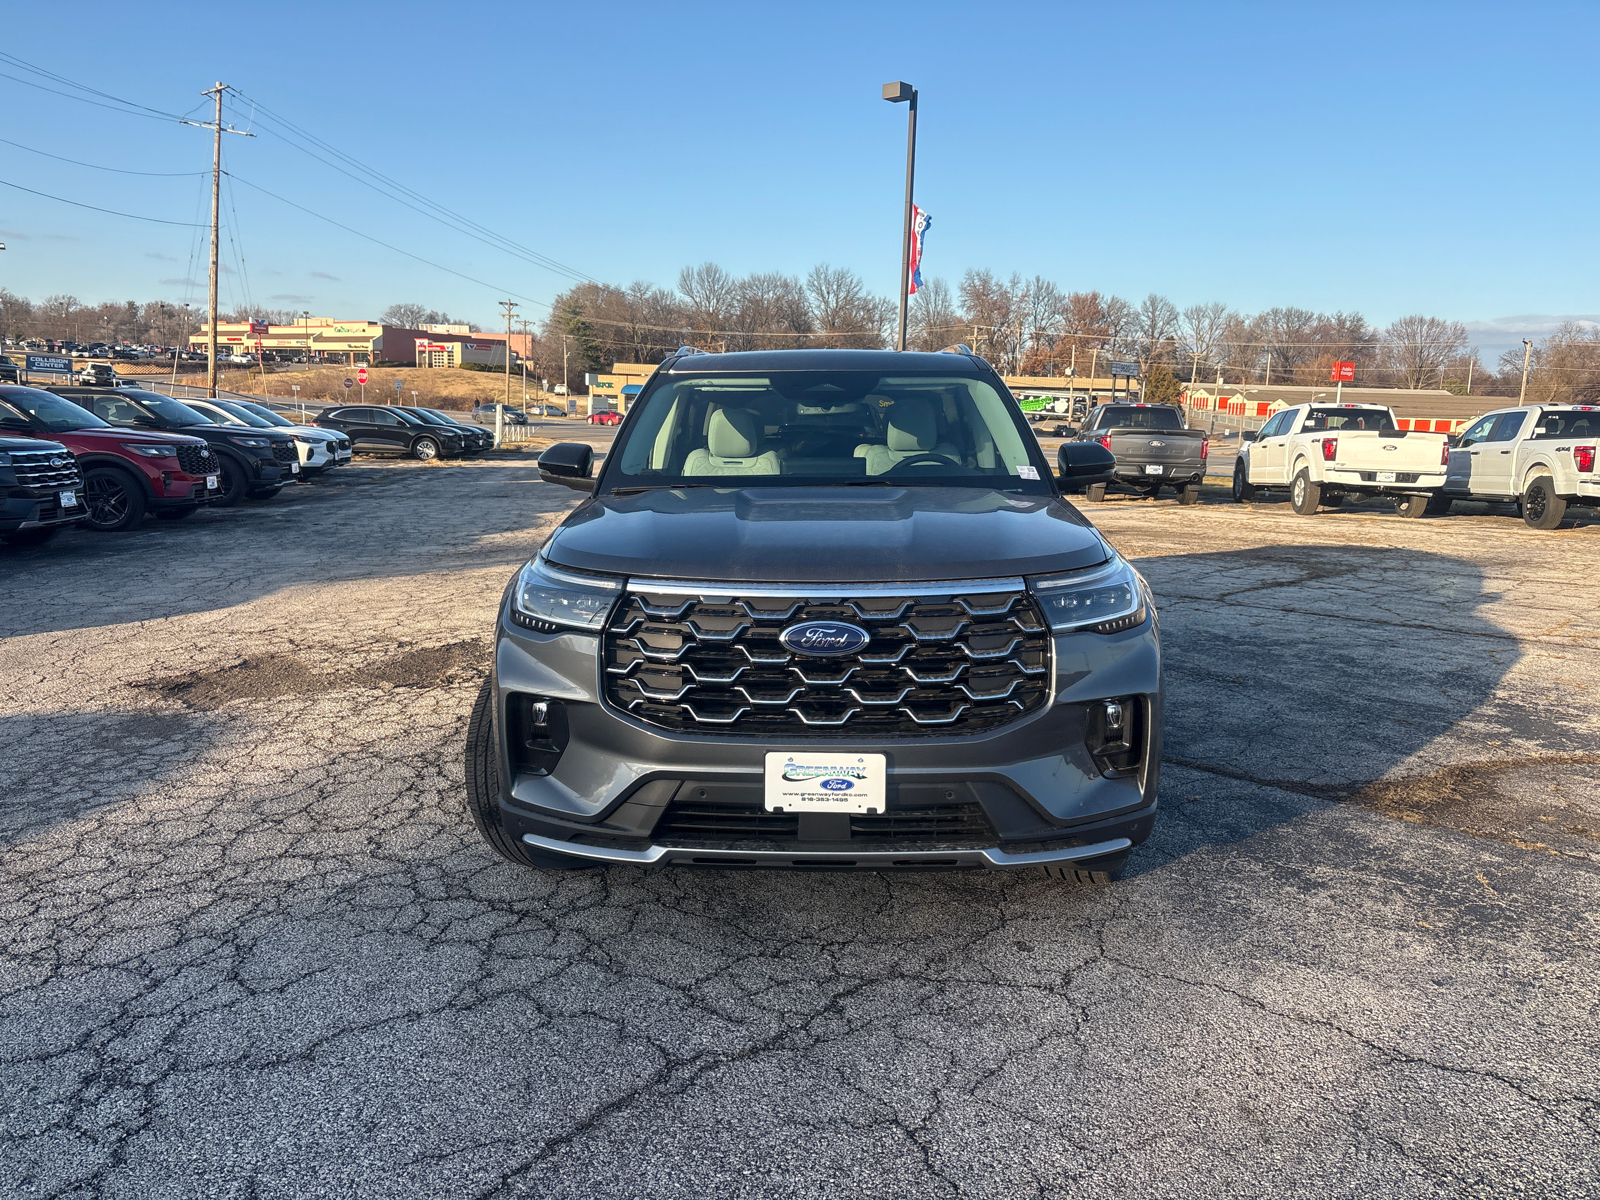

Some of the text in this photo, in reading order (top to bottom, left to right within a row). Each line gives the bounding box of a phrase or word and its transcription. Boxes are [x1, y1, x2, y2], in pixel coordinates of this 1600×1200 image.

[30, 356, 69, 364] COLLISION
[801, 628, 849, 648] Ford
[783, 763, 867, 777] GREENWAY
[827, 780, 848, 790] Ford
